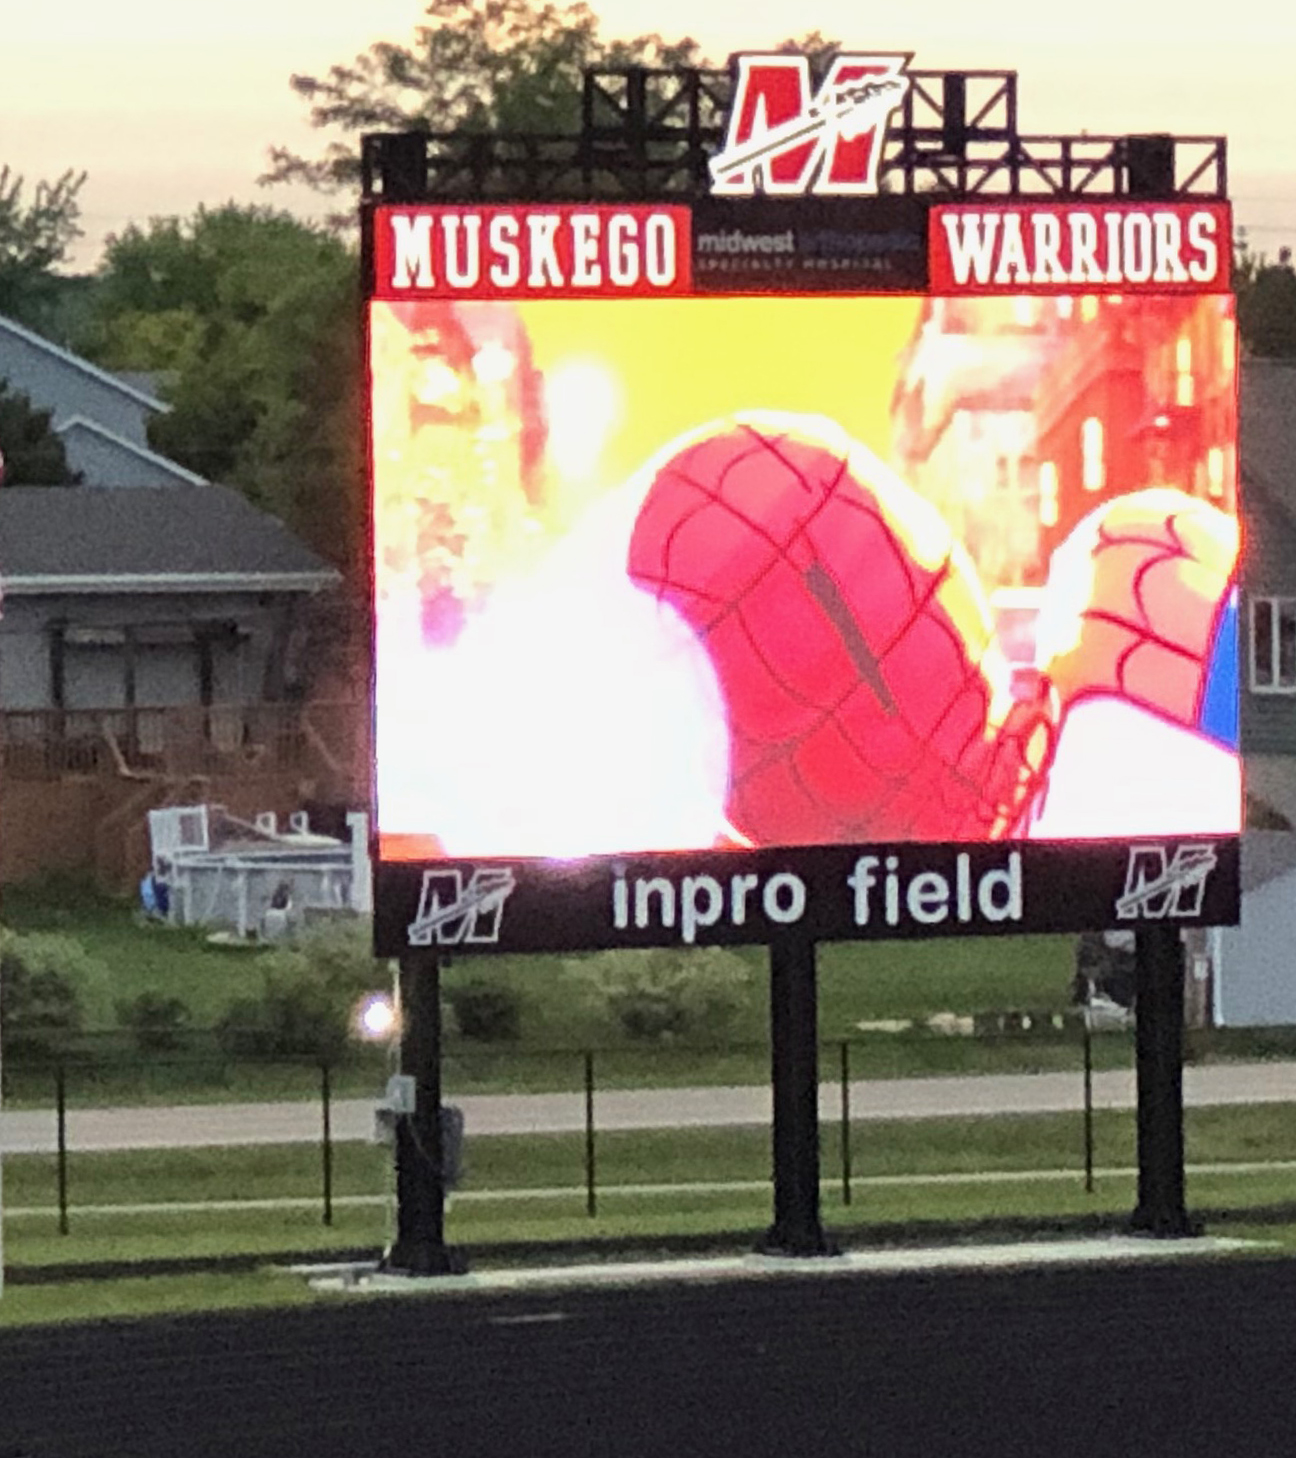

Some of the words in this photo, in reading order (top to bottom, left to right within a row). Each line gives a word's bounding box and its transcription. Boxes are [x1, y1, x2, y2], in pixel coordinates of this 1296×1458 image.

[390, 212, 676, 288] MUSKEGO
[698, 229, 795, 252] midwest
[940, 211, 1218, 285] WARRIORS
[612, 859, 807, 944] inpro
[846, 851, 1023, 927] field
